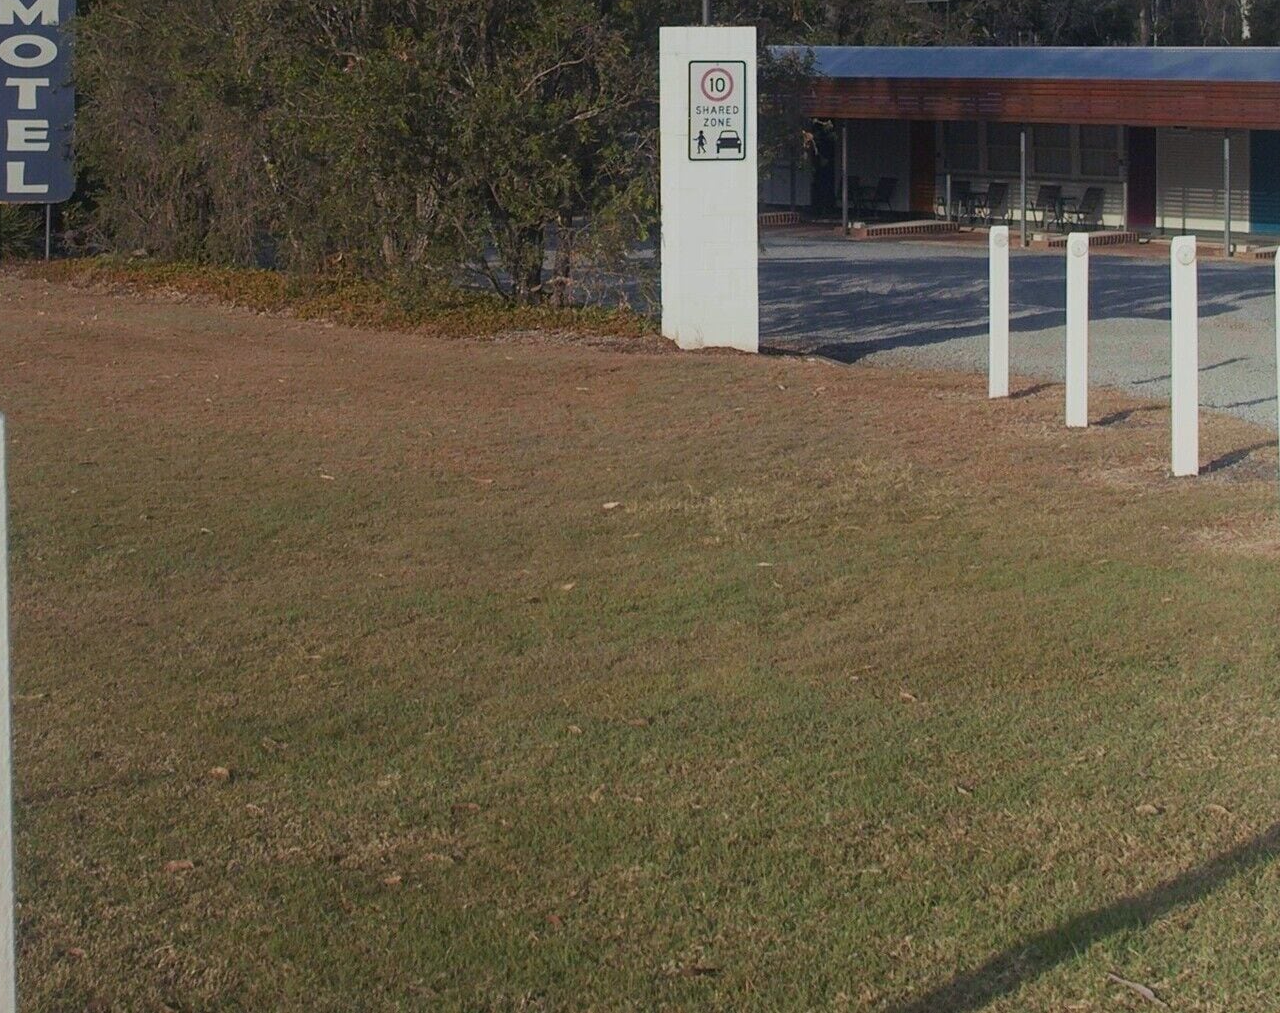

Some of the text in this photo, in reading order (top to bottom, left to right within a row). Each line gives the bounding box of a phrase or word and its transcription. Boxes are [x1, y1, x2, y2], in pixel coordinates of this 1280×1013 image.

[709, 77, 726, 92] 10
[696, 105, 739, 115] SHARED
[703, 118, 732, 127] ZONE
